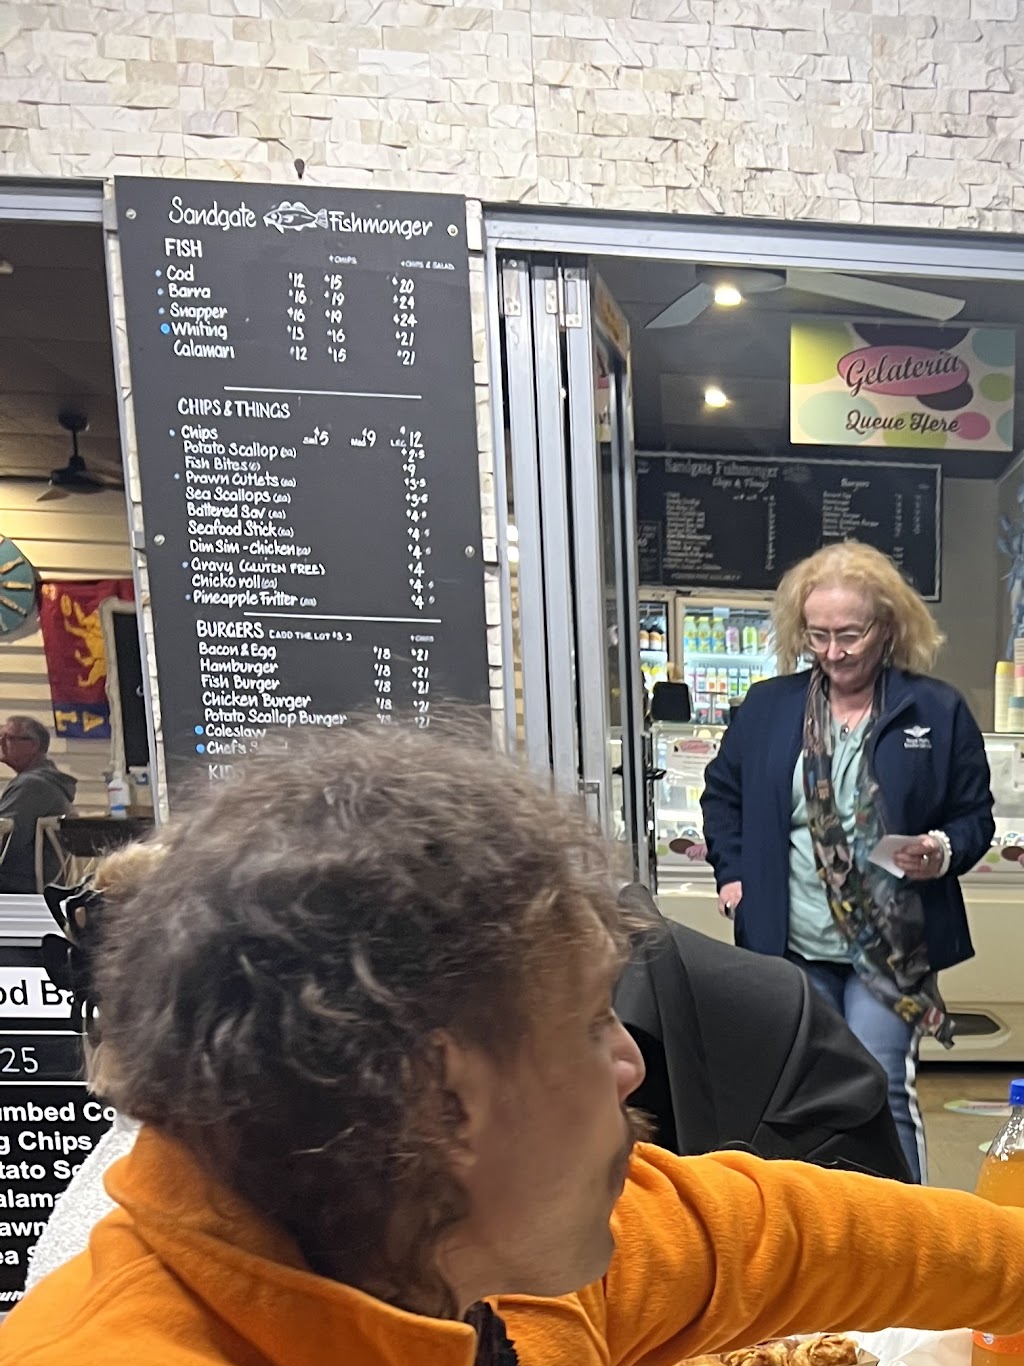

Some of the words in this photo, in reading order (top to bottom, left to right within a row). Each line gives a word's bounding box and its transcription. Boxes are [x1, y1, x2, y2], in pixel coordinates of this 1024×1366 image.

[168, 195, 257, 231] Sandgate
[329, 210, 433, 240] Fishmonger
[164, 237, 203, 258] FISH
[166, 263, 195, 281] Cod
[168, 282, 211, 299] Barra
[169, 301, 228, 321] Snapper
[171, 321, 228, 341] Whiting
[173, 338, 235, 359] Calamari
[846, 350, 961, 397] Gelateria
[846, 409, 905, 435] Queue
[910, 412, 961, 434] Here
[180, 425, 218, 441] Chips
[183, 441, 226, 455] Potato
[229, 443, 279, 461] Scallop
[185, 456, 210, 470] Fish
[213, 458, 248, 471] Bites
[185, 472, 229, 485] Prawn
[231, 472, 279, 487] Cutlets
[185, 487, 213, 500] Sea
[215, 488, 271, 504] Scallops
[187, 503, 237, 518] Battered
[241, 507, 266, 519] Sav
[187, 519, 242, 537] Seafood
[243, 521, 278, 537] Stick
[189, 539, 214, 553] Dim
[216, 540, 240, 554] Sim
[190, 556, 234, 574] Gravy
[191, 574, 237, 589] Chicko
[238, 575, 261, 589] roll
[193, 590, 257, 608] Pineapple
[258, 592, 299, 607] Fritter
[196, 620, 264, 639] BURGERS
[198, 642, 239, 656] Bacon
[250, 644, 277, 659] Egg
[200, 658, 278, 677] Hamburger
[201, 674, 229, 688] Fish
[233, 675, 280, 693] Burger
[202, 691, 258, 707] Chicken
[262, 691, 312, 710] Burger
[204, 709, 246, 723] Potato
[249, 710, 297, 728] Scallop
[299, 714, 348, 728] Burger
[205, 723, 267, 738] Coleslaw
[18, 1131, 93, 1155] Chips
